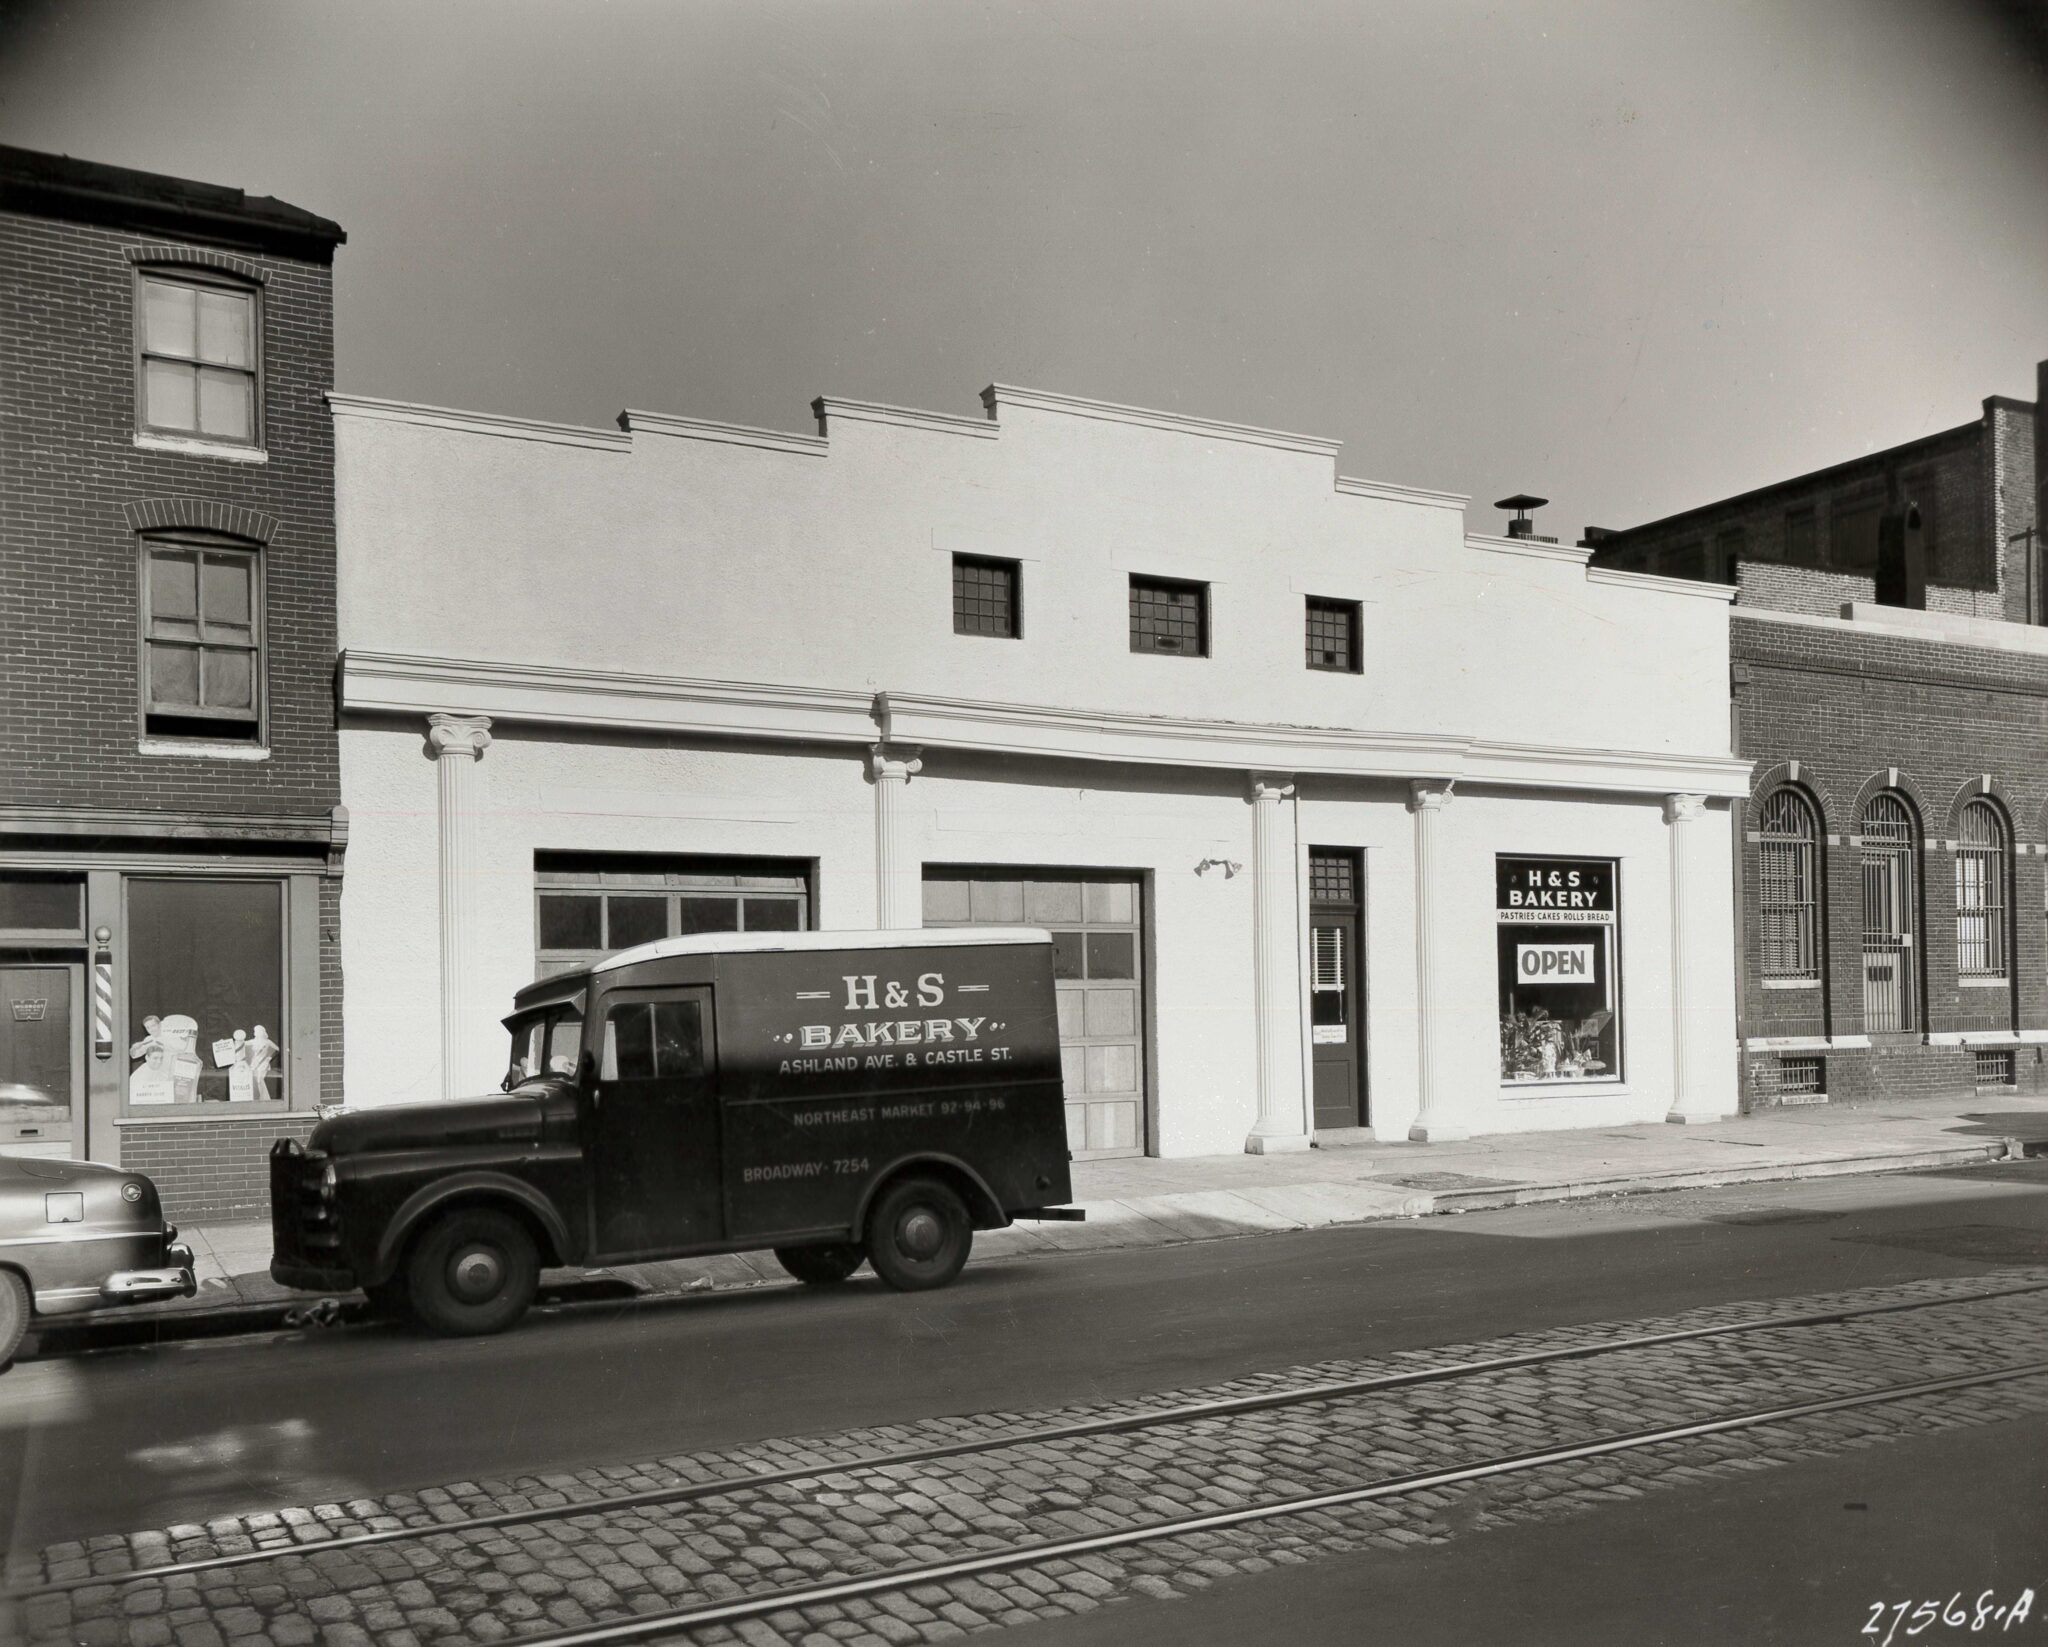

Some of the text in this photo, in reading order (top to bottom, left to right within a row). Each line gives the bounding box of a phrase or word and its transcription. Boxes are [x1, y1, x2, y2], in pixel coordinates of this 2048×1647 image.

[1509, 889, 1598, 908] BAKERY
[1500, 911, 1610, 922] PASTRIES CAKES ROLLS BREAD
[1521, 949, 1586, 976] OPEN
[842, 973, 945, 1010] H&S
[800, 1017, 987, 1050] BAKERY
[779, 1047, 1013, 1075] ASHLAND AVE. & CASTLE ST.
[793, 1107, 874, 1126] NORTHEAST
[881, 1102, 934, 1120] MARKET
[832, 1157, 869, 1174] 7254
